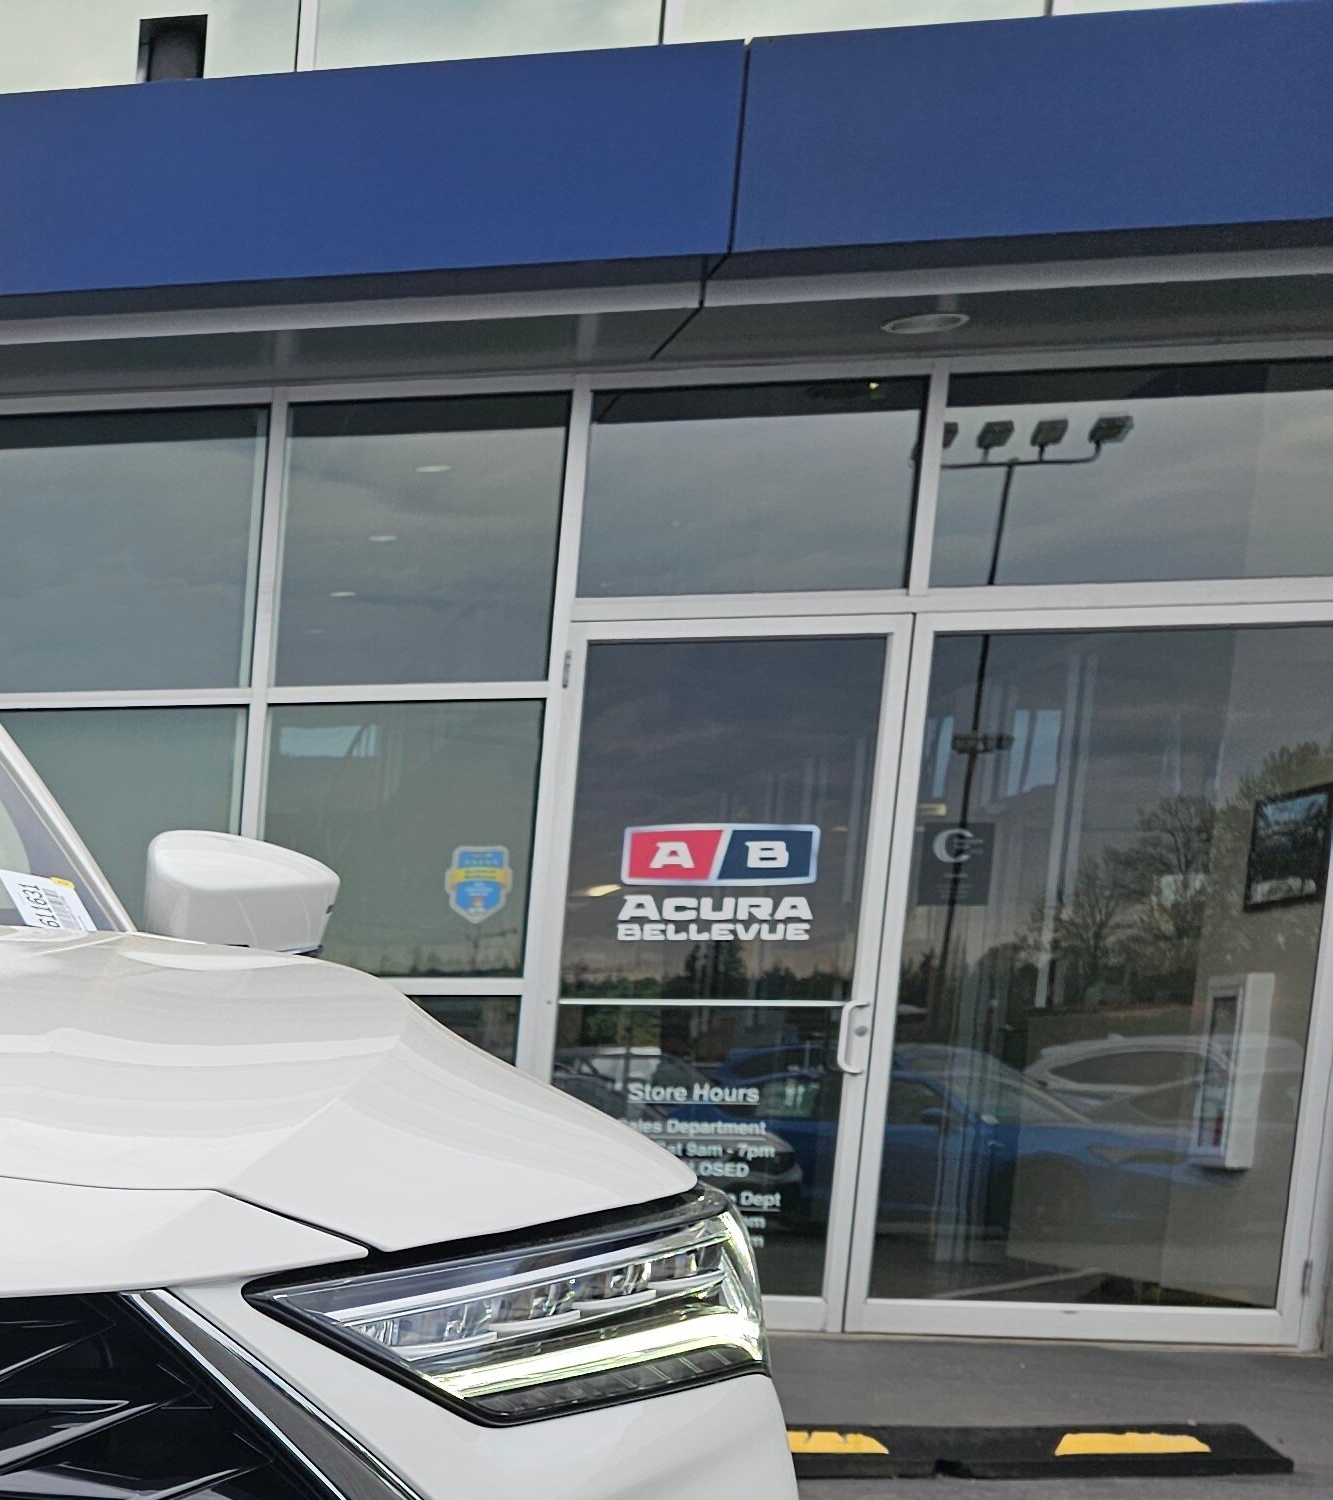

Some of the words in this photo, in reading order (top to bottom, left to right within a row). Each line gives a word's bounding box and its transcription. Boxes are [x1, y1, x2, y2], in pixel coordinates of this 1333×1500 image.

[649, 842, 695, 869] A
[744, 841, 790, 868] B
[617, 894, 813, 921] ACURA
[617, 923, 811, 941] BELLEVUE
[627, 1082, 688, 1101] Store
[693, 1082, 760, 1102] Hours
[619, 1117, 662, 1134] ales
[666, 1118, 767, 1136] Department
[686, 1142, 723, 1157] 9am
[738, 1142, 776, 1161] 7pm
[740, 1191, 781, 1210] Dept
